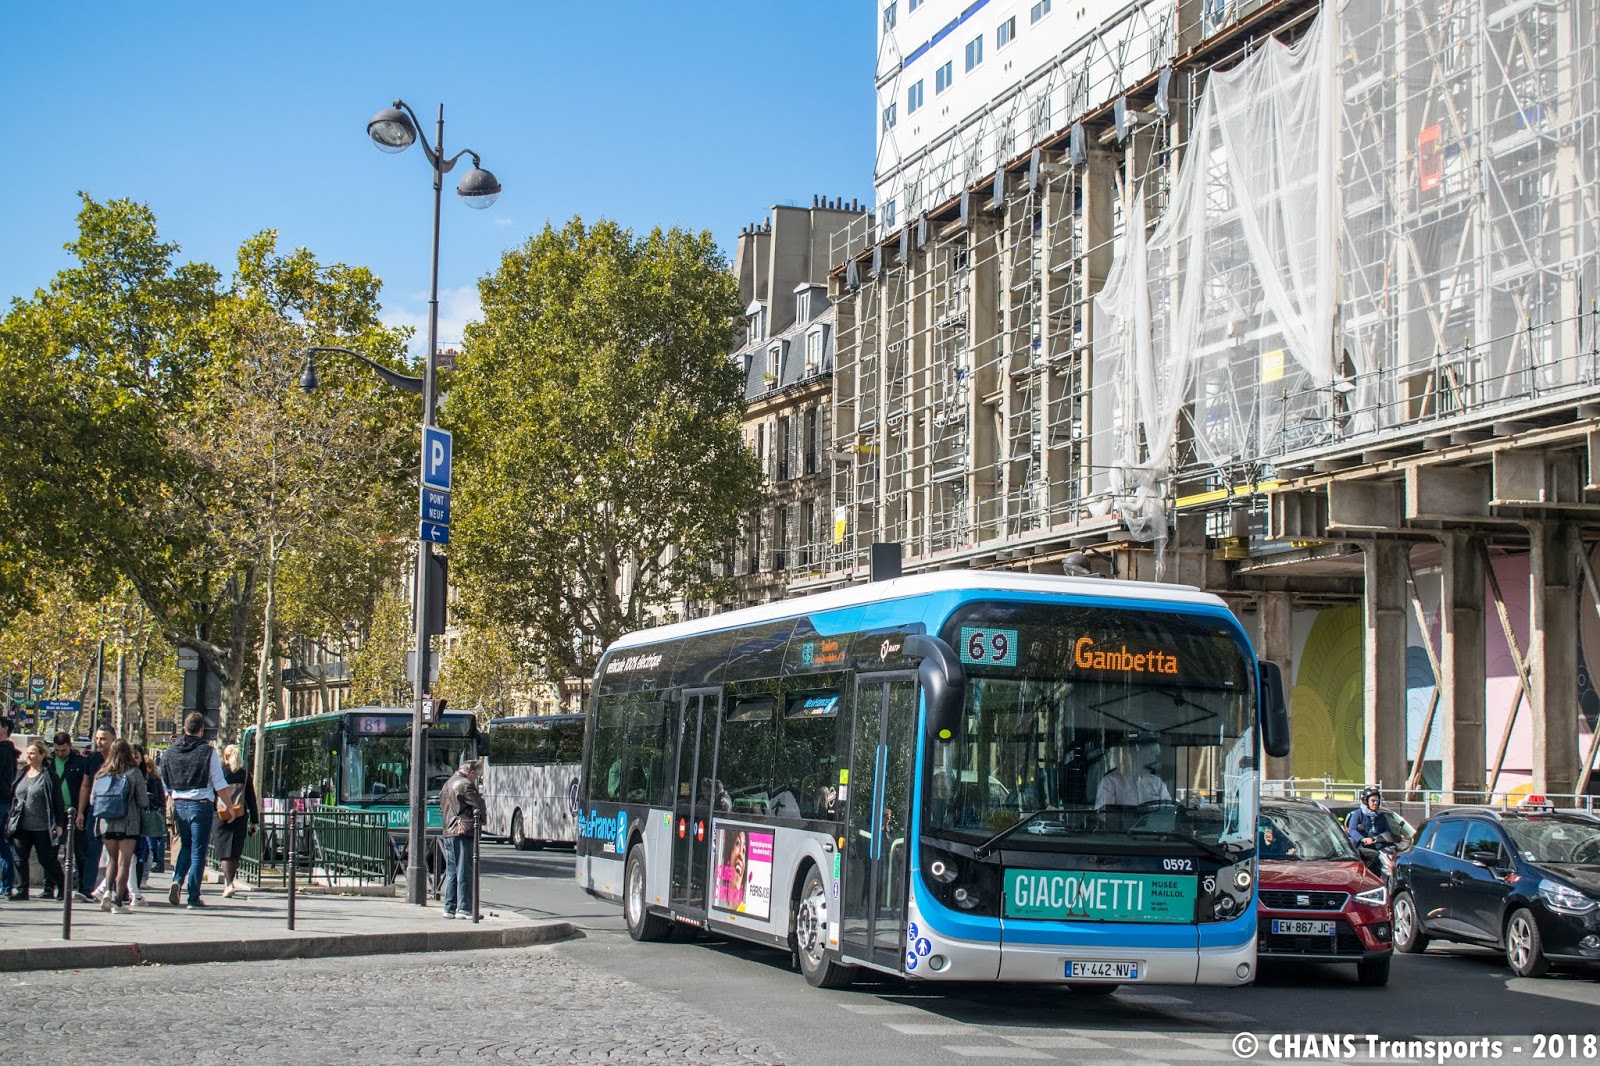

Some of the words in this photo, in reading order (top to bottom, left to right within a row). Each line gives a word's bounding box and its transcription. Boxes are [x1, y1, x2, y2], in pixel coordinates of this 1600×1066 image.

[432, 440, 444, 475] P
[429, 493, 444, 505] PONT
[429, 508, 444, 520] NEUF
[967, 631, 1009, 662] 69
[1075, 637, 1178, 674] Gambetta
[364, 719, 382, 732] 81
[1163, 859, 1193, 870] 0592
[1151, 880, 1178, 888] MUSÉE
[1015, 874, 1143, 910] GIACOMETTI
[1151, 890, 1184, 898] MAILLOL
[1280, 922, 1329, 933] EW-867-JC
